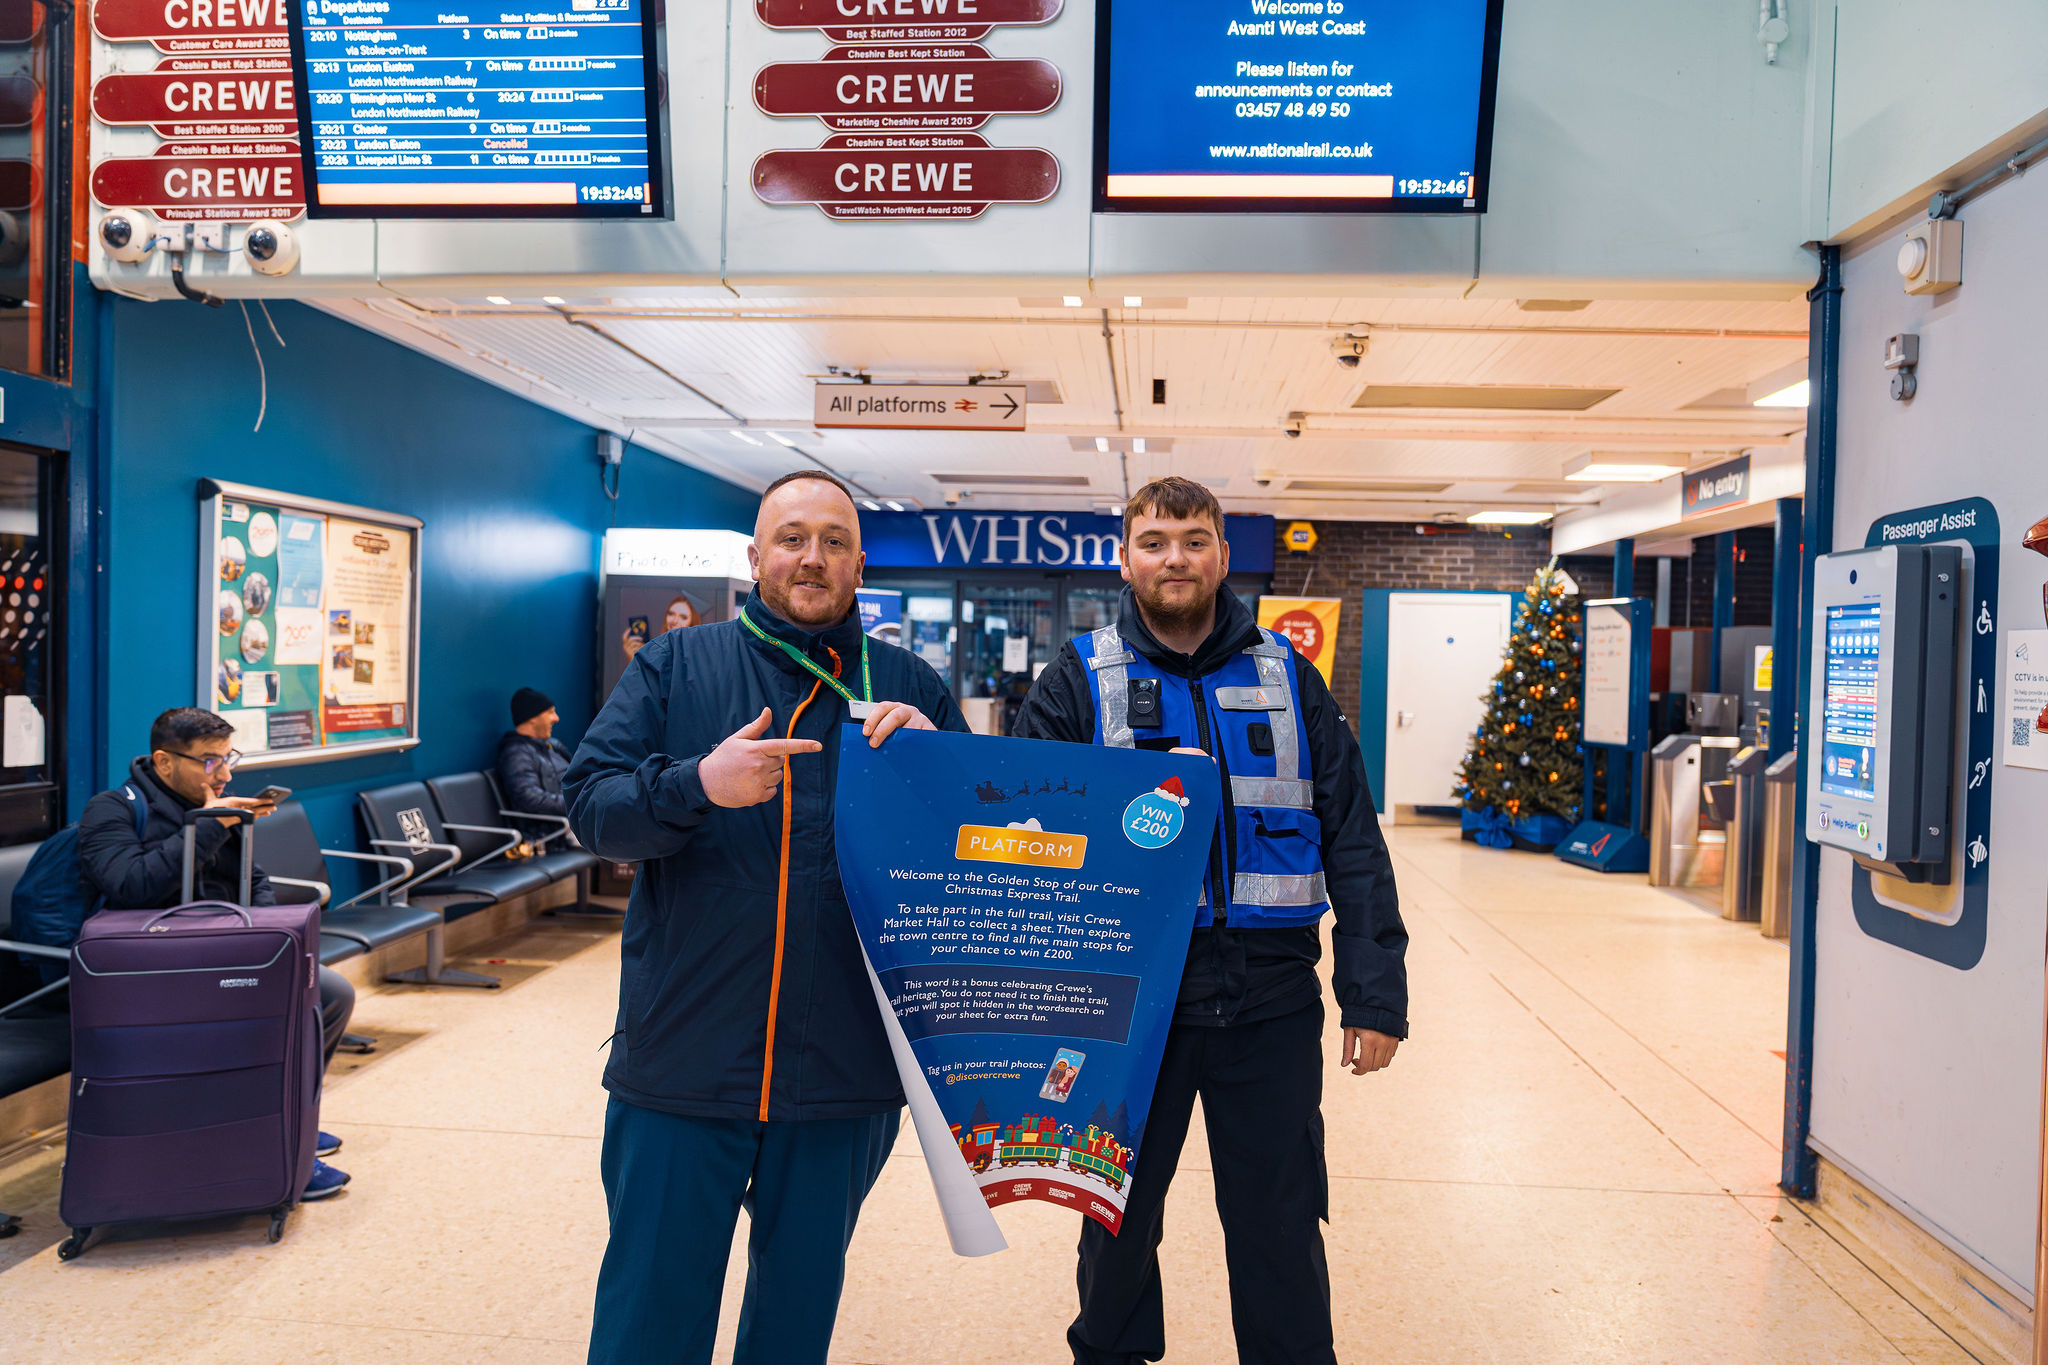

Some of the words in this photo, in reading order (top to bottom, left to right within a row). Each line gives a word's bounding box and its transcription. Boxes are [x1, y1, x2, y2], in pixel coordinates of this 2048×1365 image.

[321, 0, 390, 16] Departures
[836, 0, 977, 17] CREWE
[1252, 0, 1323, 14] Welcome
[1327, 0, 1344, 14] to
[846, 29, 867, 39] Best
[870, 29, 904, 39] Staffed
[908, 28, 941, 37] Station
[944, 28, 966, 37] 2012
[1227, 20, 1275, 35] Avanti
[1279, 20, 1319, 35] West
[1322, 20, 1366, 35] Coast
[310, 31, 337, 41] 20:10
[344, 30, 397, 43] Nottingham
[463, 29, 470, 40] 3
[484, 29, 499, 39] On
[499, 29, 521, 39] time
[170, 40, 211, 50] Customer
[212, 39, 233, 49] Care
[235, 39, 262, 48] Award
[345, 46, 359, 55] via
[360, 44, 427, 55] Stoke-on-Trent
[848, 50, 885, 58] Cheshire
[888, 49, 908, 58] Best
[910, 49, 931, 58] Kept
[933, 49, 965, 57] Station
[172, 60, 209, 70] Cheshire
[211, 60, 231, 69] Best
[233, 59, 254, 71] Kept
[255, 59, 288, 69] Station
[313, 62, 340, 73] 20:13
[347, 62, 382, 72] London
[383, 62, 414, 72] Euston
[465, 61, 472, 71] 7
[486, 61, 501, 71] On
[501, 61, 523, 71] time
[1237, 61, 1284, 76] Please
[1288, 61, 1327, 76] listen
[1331, 60, 1354, 76] for
[348, 76, 383, 87] London
[444, 75, 477, 87] Railway
[165, 80, 293, 112] CREWE
[837, 74, 973, 104] CREWE
[1195, 83, 1313, 97] announcements
[1316, 85, 1333, 96] or
[1336, 82, 1393, 97] contact
[1236, 103, 1281, 117] 03457
[1284, 102, 1303, 117] 48
[1307, 103, 1327, 117] 49
[1330, 102, 1350, 117] 50
[837, 118, 879, 127] Marketing
[882, 118, 919, 126] Cheshire
[922, 117, 949, 125] Award
[951, 117, 972, 125] 2013
[846, 139, 884, 147] Cheshire
[886, 138, 906, 146] Best
[909, 138, 929, 147] Kept
[932, 138, 963, 146] Station
[1210, 142, 1373, 157] www.nationalrail.co.uk
[164, 167, 292, 198] CREWE
[835, 163, 972, 192] CREWE
[581, 186, 643, 200] 19:52:45
[1399, 179, 1466, 194] 19:52:46
[166, 209, 203, 219] Principal
[204, 208, 240, 219] Stations
[242, 208, 269, 217] Award
[271, 208, 290, 217] 2011
[883, 206, 925, 214] NorthWest
[926, 206, 951, 214] Award
[952, 206, 972, 214] 2015
[830, 396, 852, 412] All
[858, 396, 946, 416] platforms
[1699, 477, 1714, 500] No
[1715, 472, 1744, 496] entry
[1883, 518, 1939, 541] Passenger
[1940, 508, 1976, 531] Assist
[921, 514, 1121, 565] WHSm
[2014, 673, 2031, 681] CCTV
[1143, 804, 1172, 824] WIN
[1130, 817, 1169, 838] £200
[970, 836, 1073, 858] PLATFORM
[890, 869, 943, 880] Welcome
[965, 872, 983, 882] the
[988, 873, 1029, 886] Golden
[1033, 877, 1059, 890] Stop
[1063, 880, 1076, 889] of
[1103, 883, 1140, 895] Crewe
[945, 884, 1003, 897] Christmas
[1008, 888, 1051, 901] Express
[1054, 892, 1080, 902] Trail.
[898, 904, 911, 913] To
[916, 904, 939, 913] take
[943, 907, 967, 916] part
[971, 906, 980, 915] in
[985, 907, 1003, 917] the
[1008, 908, 1025, 918] full
[1029, 911, 1054, 921] trail,
[1058, 913, 1080, 922] visit
[1084, 914, 1120, 926] Crewe
[884, 917, 923, 928] Market
[927, 917, 949, 926] Hall
[969, 919, 1008, 930] collect
[1021, 922, 1054, 933] sheet.
[1057, 924, 1084, 935] Then
[1088, 929, 1130, 939] explore
[931, 946, 957, 955] your
[961, 944, 999, 954] chance
[1020, 948, 1039, 957] win
[1044, 949, 1073, 959] £200.
[936, 1013, 957, 1022] your
[1032, 1013, 1048, 1021] fun.
[927, 1066, 940, 1076] Tag
[965, 1062, 986, 1070] your
[1011, 1060, 1046, 1069] photos:
[946, 1073, 1020, 1085] @discovercrewe
[1090, 1201, 1115, 1221] CREWE
